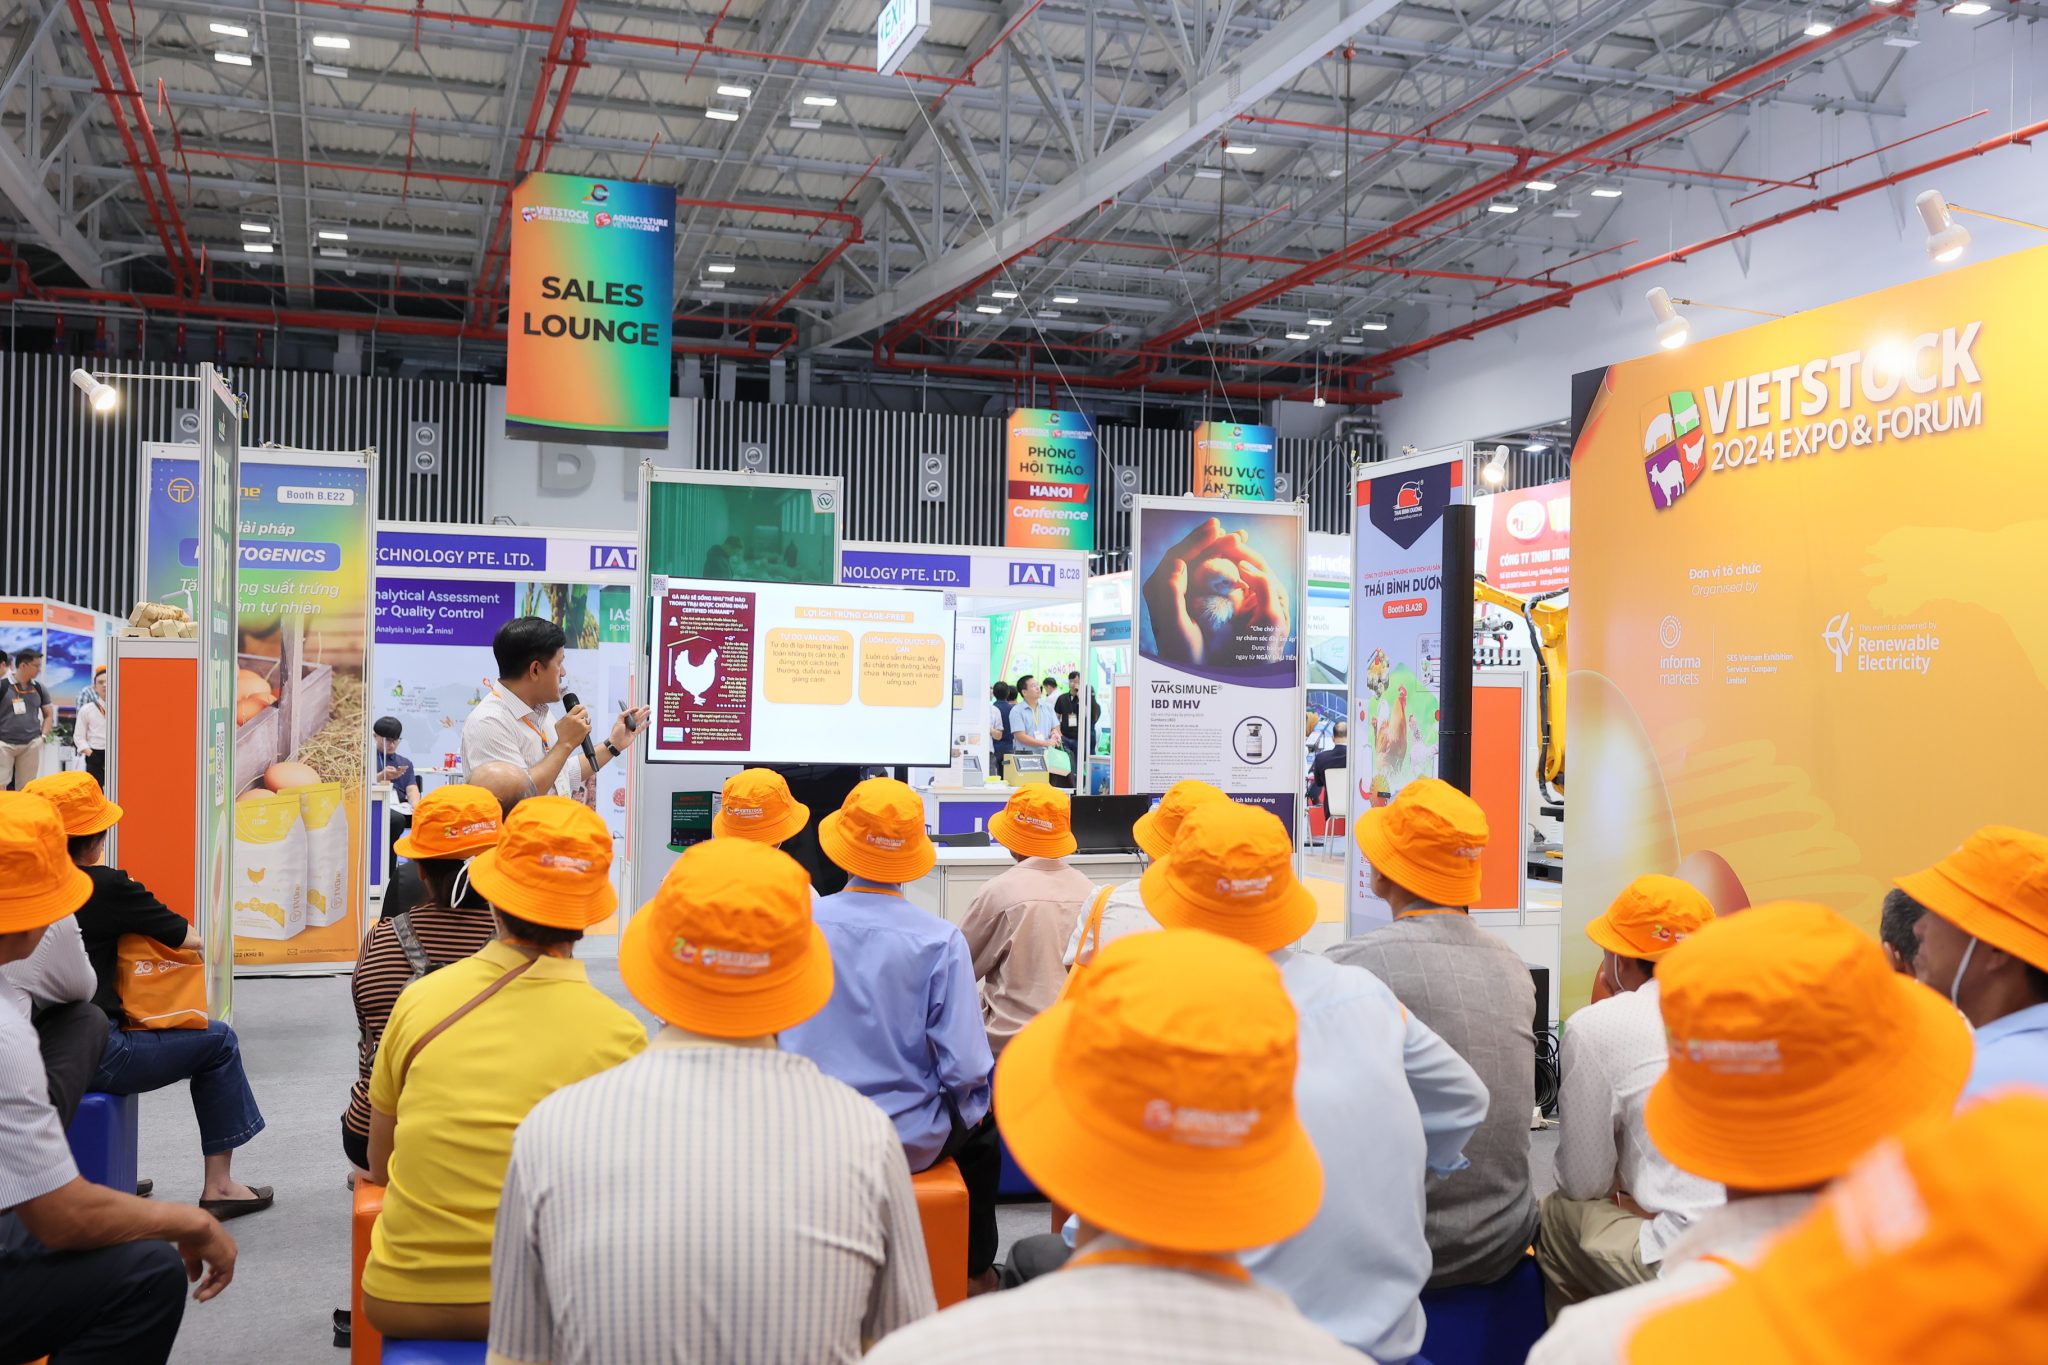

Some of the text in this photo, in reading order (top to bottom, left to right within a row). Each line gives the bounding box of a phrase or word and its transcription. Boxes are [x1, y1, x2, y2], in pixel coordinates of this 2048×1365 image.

[536, 206, 588, 219] VIETSTOCK
[613, 214, 668, 226] AQUACULTURE
[542, 276, 643, 307] SALES
[524, 312, 659, 346] LOUNGE
[1703, 321, 1982, 435] VIETSTOCK
[1711, 392, 1981, 471] 2024 EXPO & FORUM
[1028, 445, 1076, 458] PHÒNG
[1020, 460, 1084, 476] HỘI THẢO
[1205, 466, 1264, 481] KHU VỰC
[287, 491, 344, 500] Booth B.E22
[1030, 485, 1072, 498] HANOI
[1227, 484, 1264, 496] TRƯA
[1013, 506, 1088, 520] Conference
[240, 520, 295, 536] iải pháp
[1031, 524, 1070, 536] Room
[468, 552, 499, 564] PTE.
[504, 553, 534, 565] LTD.
[595, 548, 637, 568] IAT
[843, 566, 959, 582] NOLOGY PTE. LTD.
[1013, 565, 1049, 584] IAT
[1060, 569, 1080, 580] B.C28
[1689, 568, 1709, 579] Đơn
[263, 579, 339, 597] suất trứng
[1365, 580, 1384, 597] THÁI
[1387, 578, 1410, 594] BÌNH
[1692, 580, 1758, 598] Organised by
[428, 590, 499, 604] Assessment
[261, 601, 320, 615] tự nhiên
[391, 605, 435, 620] Quality
[439, 607, 484, 619] Control
[1388, 602, 1422, 613] Booth B.A28
[376, 626, 404, 634] Analysis
[427, 624, 433, 634] 2
[1858, 632, 1940, 652] Renewable
[1660, 655, 1700, 669] informa
[1751, 665, 1777, 673] Company
[1858, 653, 1931, 674] Electricity
[1660, 671, 1699, 685] markets
[1151, 700, 1200, 709] IBD MHV
